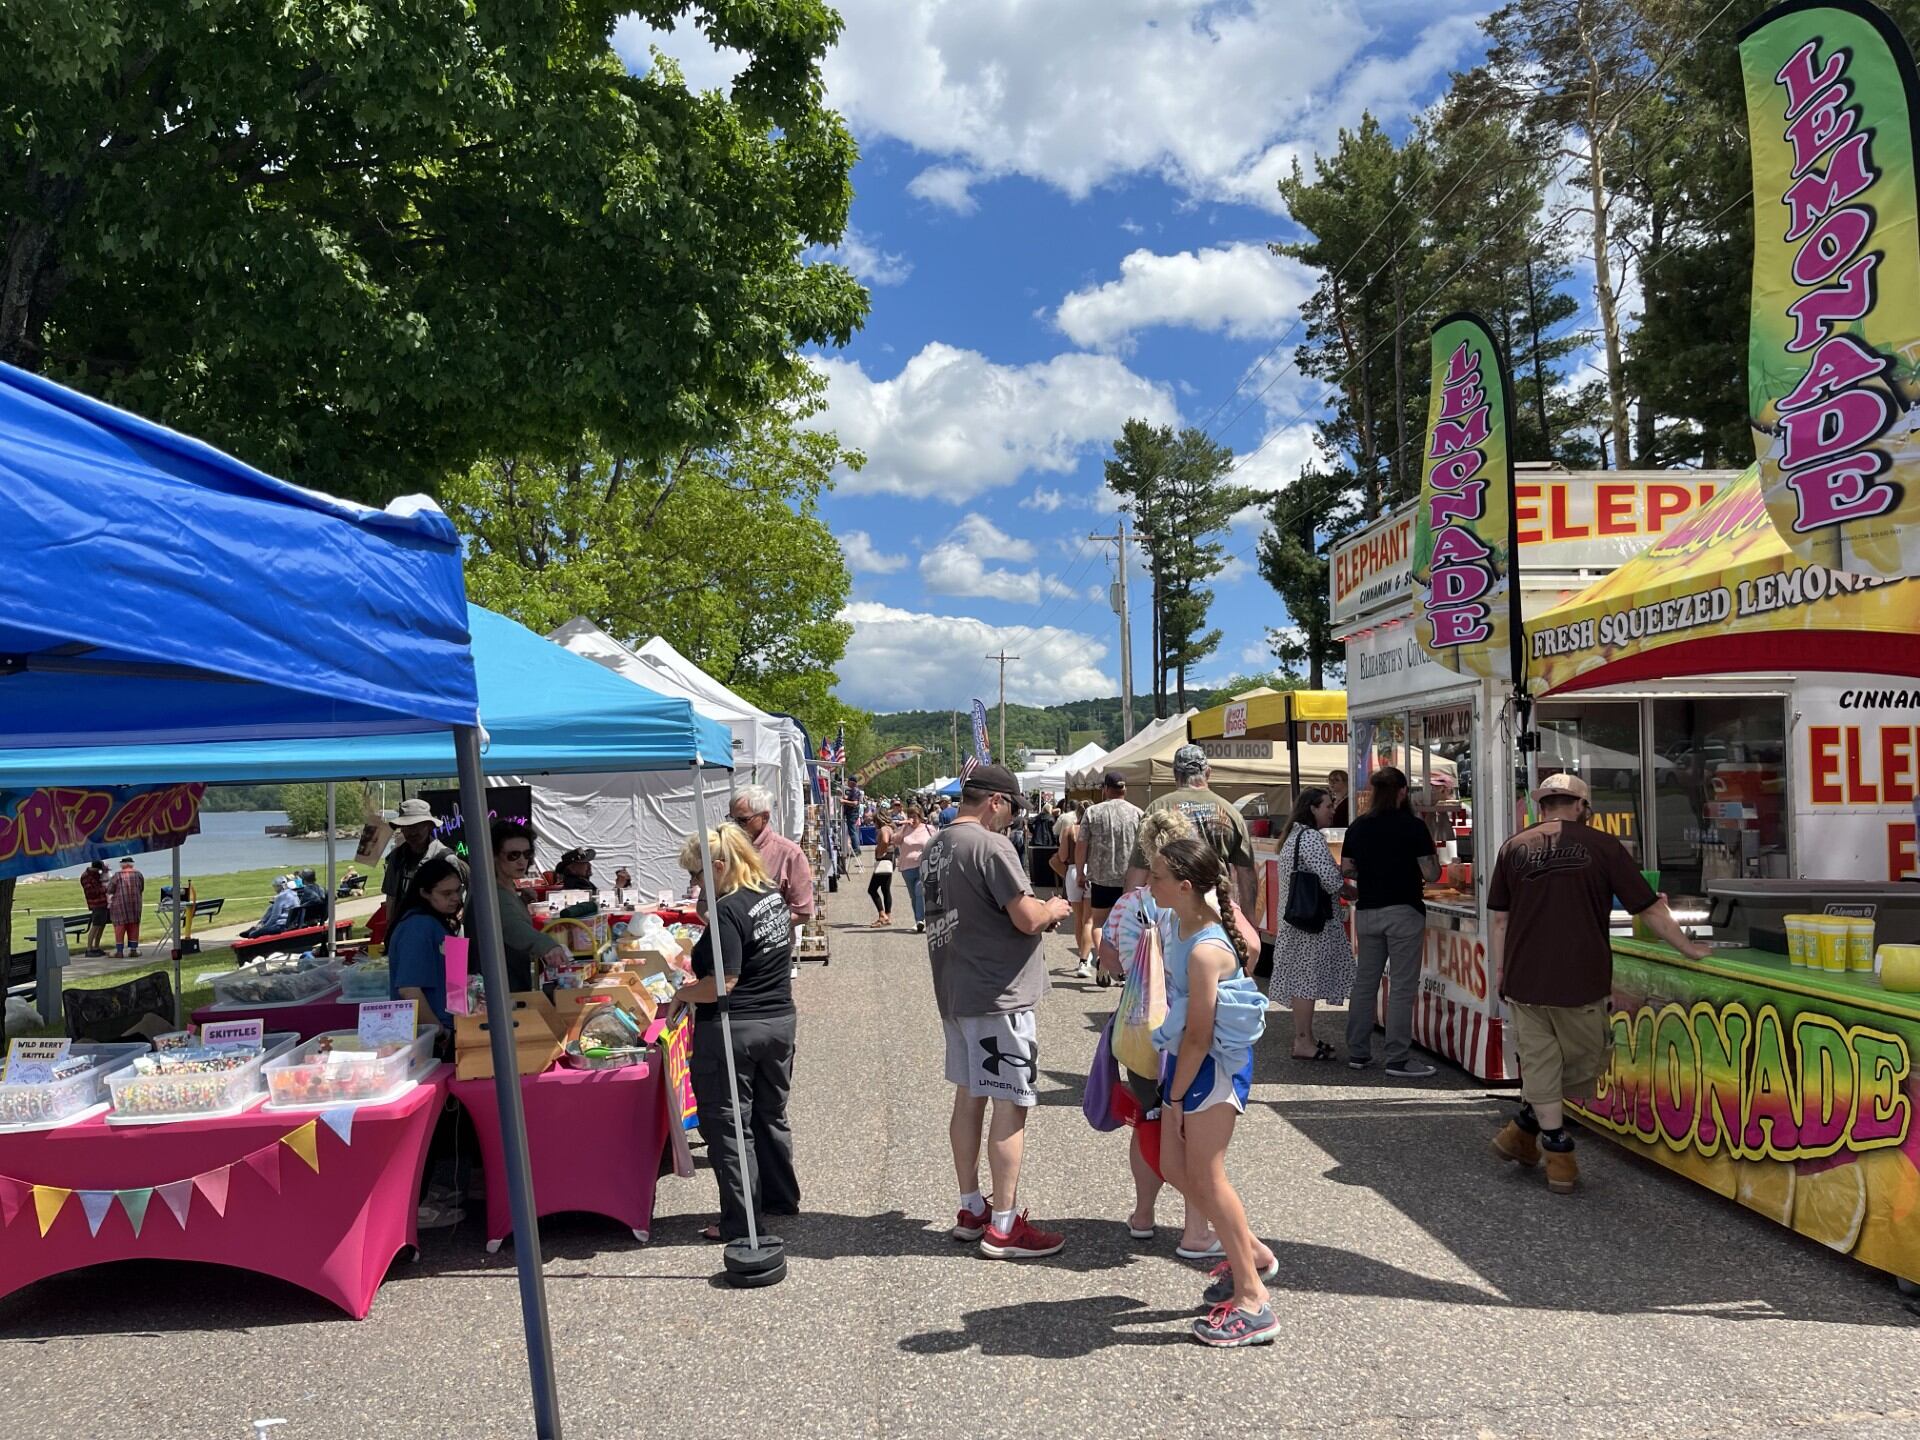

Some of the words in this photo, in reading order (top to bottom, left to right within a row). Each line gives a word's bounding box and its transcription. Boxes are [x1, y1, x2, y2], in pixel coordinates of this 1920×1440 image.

[1775, 38, 1894, 535] LEMONADE
[1425, 340, 1492, 650] LEMONADE
[1514, 483, 1714, 544] ELEP
[1336, 520, 1411, 603] ELEPHANT
[1359, 577, 1393, 605] CINNAMON
[1532, 618, 1597, 659] FRESH
[1599, 586, 1733, 647] SQUEEZED
[1737, 565, 1907, 618] LEMON
[1229, 719, 1248, 732] DOGS
[1231, 707, 1245, 720] HOT
[1423, 714, 1454, 739] THANK
[1458, 709, 1471, 736] YO
[1310, 722, 1347, 743] COR
[1808, 725, 1920, 805] ELE
[1437, 932, 1488, 1001] EARS
[1424, 977, 1446, 997] SUGAR
[40, 1041, 64, 1049] BERRY
[209, 1027, 257, 1039] SKITTLES
[979, 1079, 1013, 1091] UNDER
[1564, 1000, 1912, 1162] MONADE
